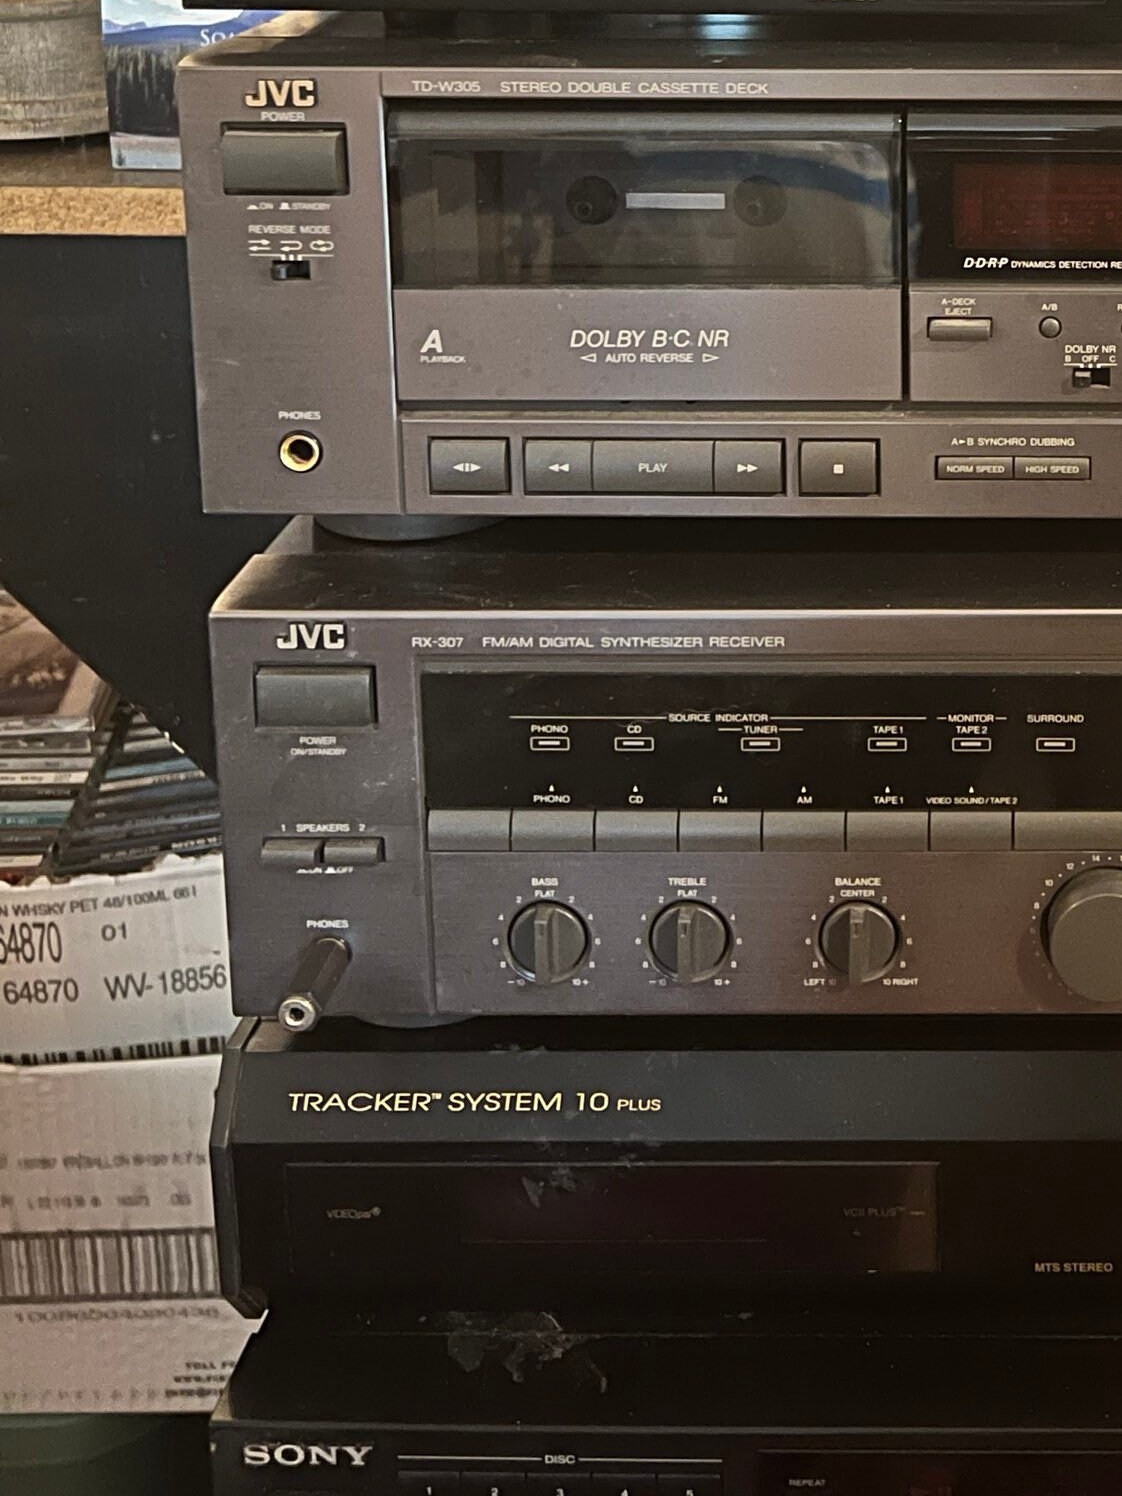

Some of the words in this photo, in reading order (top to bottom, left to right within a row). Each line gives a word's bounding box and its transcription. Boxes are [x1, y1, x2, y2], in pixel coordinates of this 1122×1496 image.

[245, 80, 314, 107] JVC
[411, 80, 482, 94] TD-W305
[499, 80, 563, 95] STEREO
[567, 80, 633, 95] DOUBLE
[637, 81, 721, 96] CASSETTE
[724, 81, 769, 96] DECK
[1010, 259, 1057, 270] DYNAMICS
[1058, 260, 1108, 270] DETECTION
[420, 330, 444, 353] A
[570, 329, 643, 349] DOLBY
[697, 330, 729, 349] NR
[1064, 344, 1100, 355] DOLBY
[1101, 344, 1117, 355] NR
[605, 352, 637, 364] AUTO
[639, 352, 695, 364] REVERSE
[637, 461, 669, 475] PLAY
[277, 624, 345, 649] JVC
[411, 636, 464, 648] RX-307
[481, 636, 535, 648] FM/AM
[538, 636, 594, 648] DIGITAL
[600, 636, 703, 649] SYNTHESIZER
[708, 637, 786, 649] RECEIVER
[667, 713, 712, 723] SOURCE
[714, 713, 769, 723] INDICATOR
[947, 713, 995, 724] MONITOR
[1025, 713, 1085, 724] SURROUND
[530, 724, 569, 734] PHONO
[626, 724, 642, 734] CD
[742, 725, 779, 735] TUNER
[532, 794, 571, 804] PHONO
[628, 794, 644, 805] CD
[712, 794, 728, 805] FM
[834, 877, 882, 887] BALANCE
[3, 981, 79, 1003] 64870
[104, 964, 226, 999] WV-18856
[448, 1093, 562, 1112] SYSTEM
[576, 1093, 609, 1112] 10
[617, 1098, 662, 1112] PLUS
[1034, 1262, 1061, 1273] MTS
[1063, 1262, 1114, 1273] STEREO
[244, 1445, 373, 1467] SONY
[544, 1454, 576, 1465] DISC
